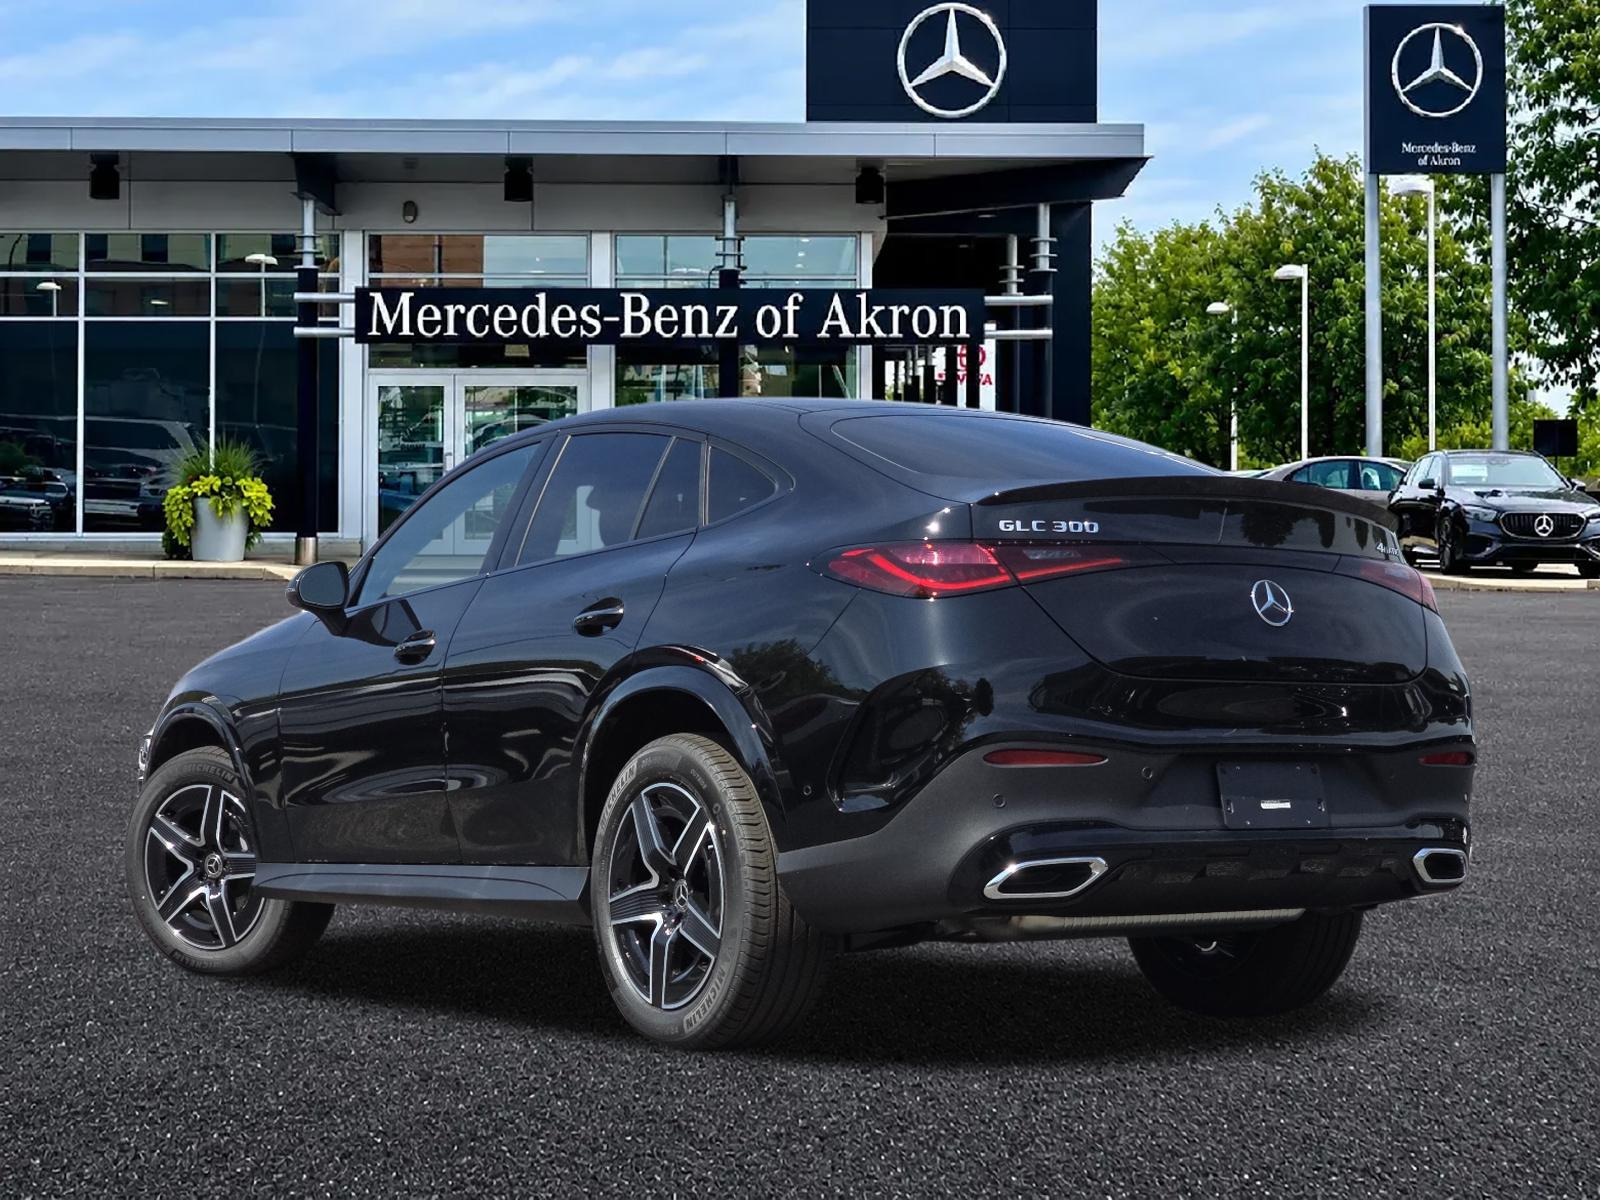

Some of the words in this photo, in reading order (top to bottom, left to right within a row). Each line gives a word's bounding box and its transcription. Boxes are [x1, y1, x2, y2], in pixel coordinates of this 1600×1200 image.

[1401, 142, 1477, 153] Mercedes-Benz
[1417, 155, 1428, 166] of
[1430, 155, 1461, 166] Akron
[367, 291, 738, 338] Mercedes-Benz
[756, 291, 804, 338] of
[816, 291, 971, 338] Akron
[998, 519, 1046, 532] GLC
[1052, 520, 1099, 533] 300
[685, 967, 726, 1031] MICHELIN
